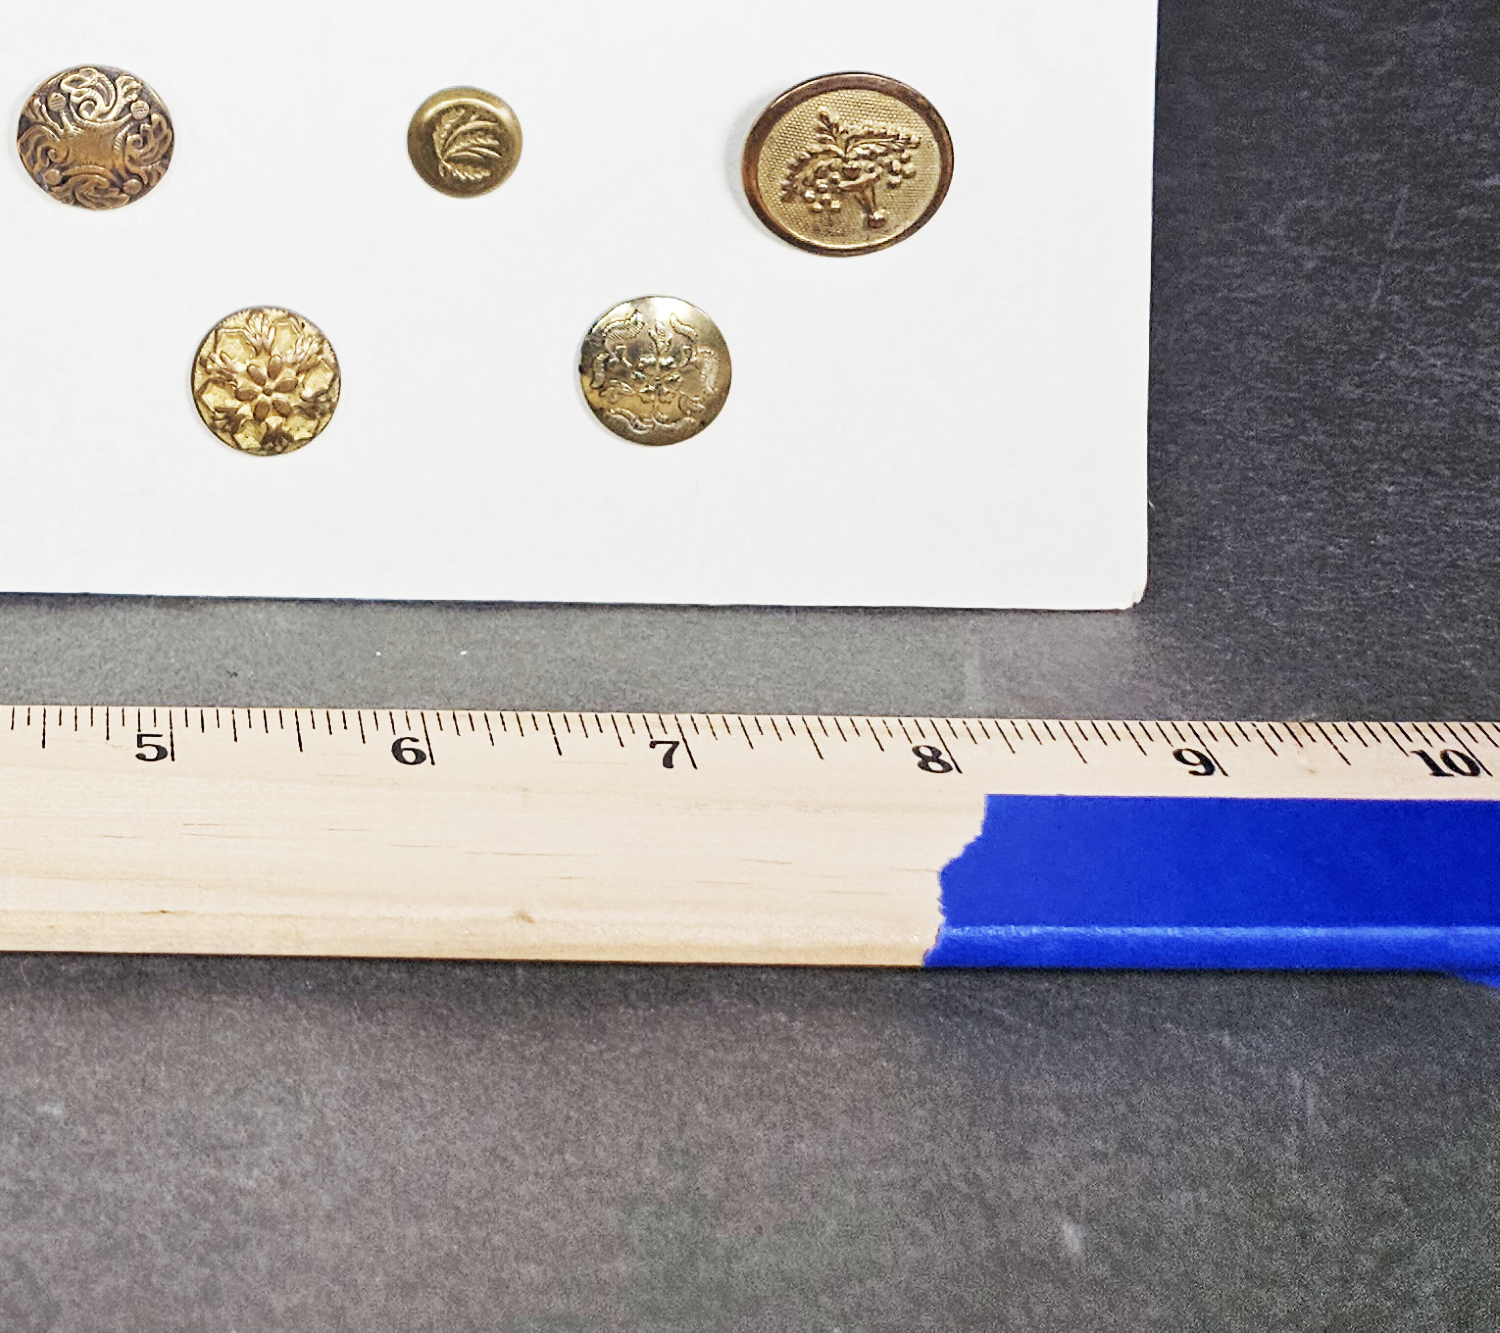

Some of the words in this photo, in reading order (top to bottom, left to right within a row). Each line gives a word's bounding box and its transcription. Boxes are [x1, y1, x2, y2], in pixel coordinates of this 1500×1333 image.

[133, 732, 172, 765] 5
[390, 735, 430, 768] 6
[648, 740, 683, 770] 7
[912, 743, 954, 775] 8
[1171, 745, 1219, 779] 9
[1409, 747, 1482, 779] 10
